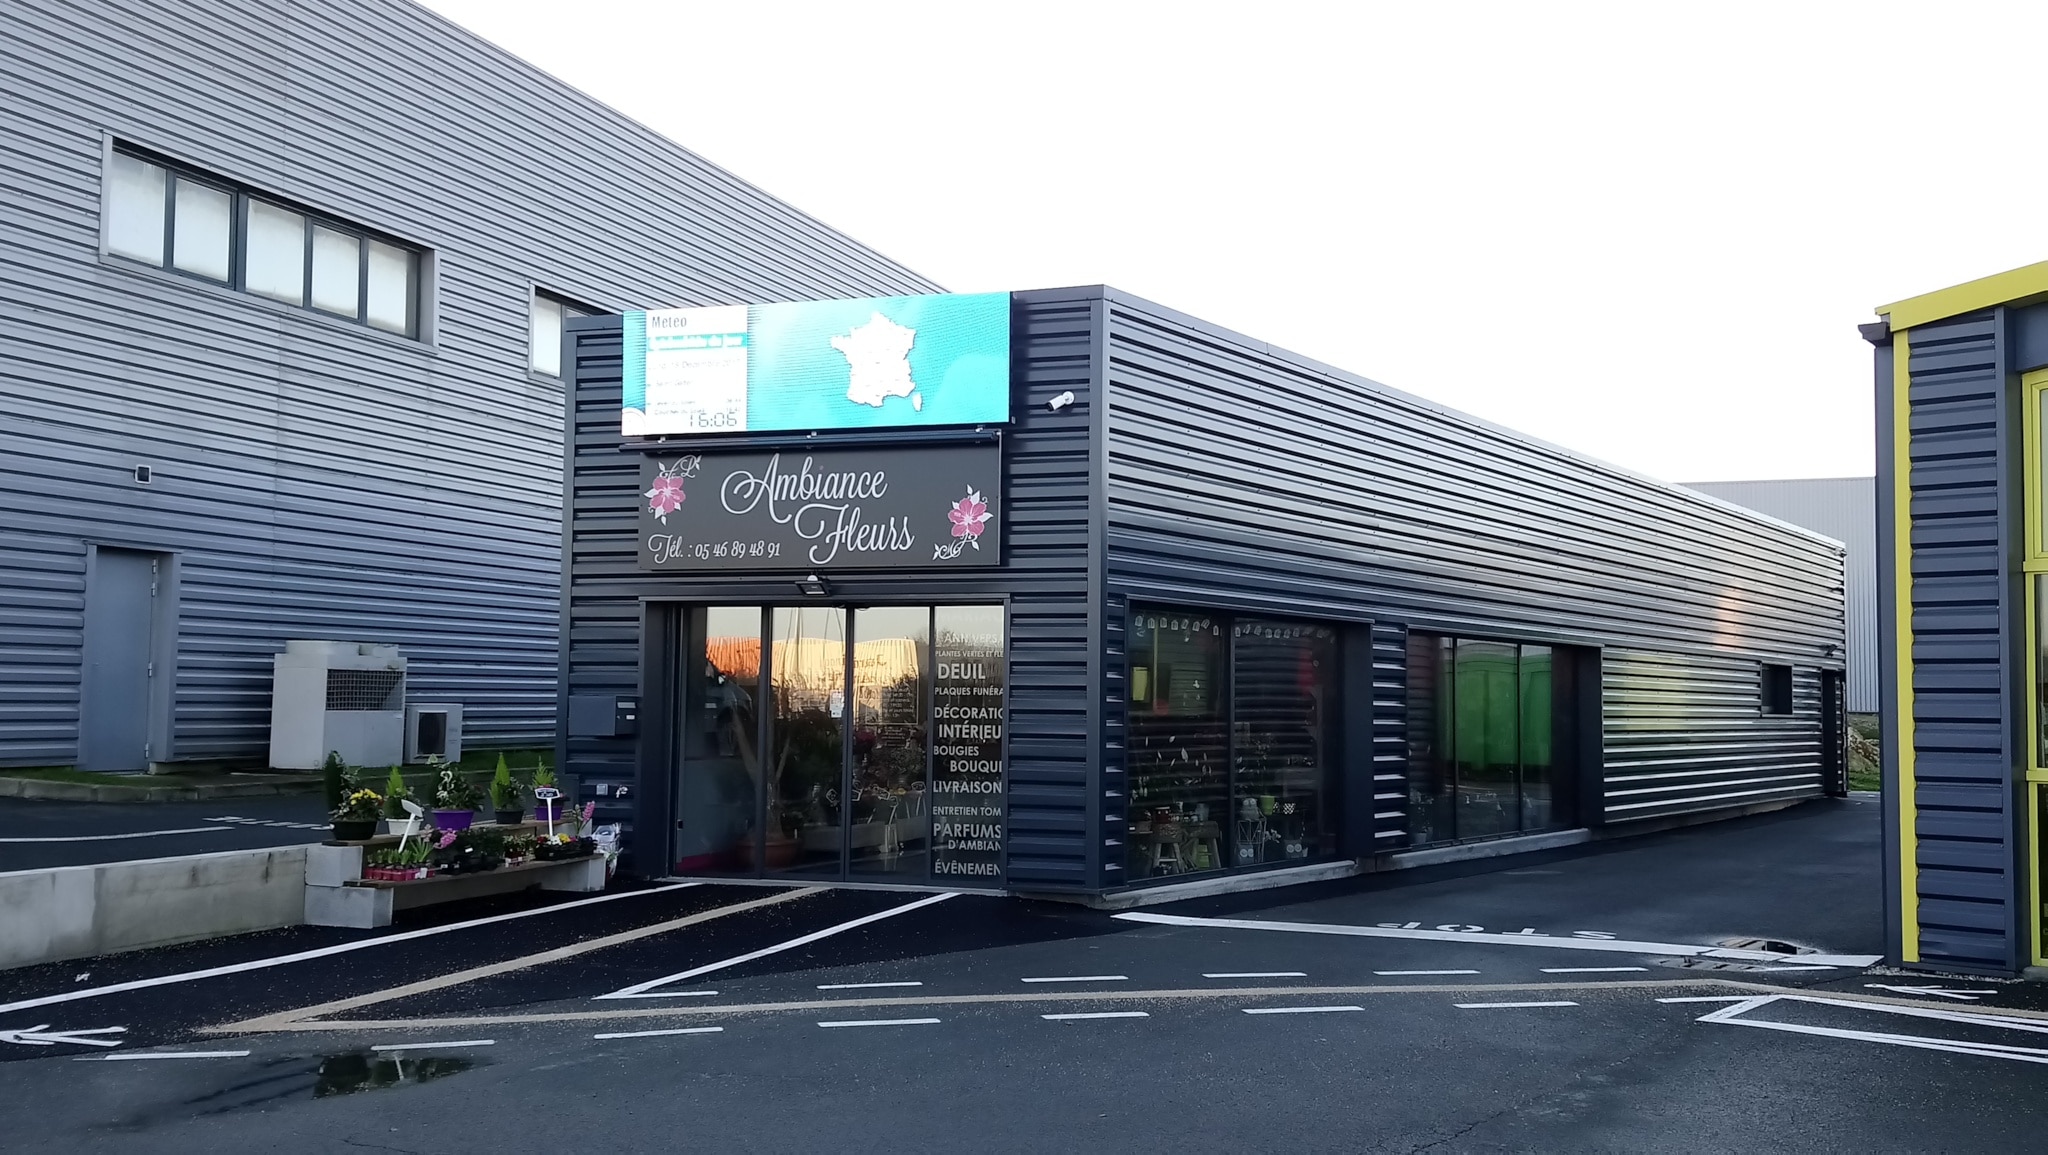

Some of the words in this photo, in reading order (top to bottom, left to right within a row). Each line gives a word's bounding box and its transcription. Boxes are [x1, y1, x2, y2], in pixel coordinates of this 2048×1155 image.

[690, 412, 738, 428] 16:06
[720, 453, 888, 524] Ambiance
[794, 503, 915, 564] Fleurs
[648, 533, 683, 564] Tél.
[695, 543, 710, 560] 05
[713, 541, 729, 557] 46
[731, 540, 746, 558] 89
[749, 540, 765, 557] 48
[768, 542, 781, 558] 91
[938, 663, 986, 680] DEUIL
[934, 686, 971, 696] PLAQUES
[933, 745, 979, 756] BOUGIES
[933, 780, 1002, 793] LIVRAISON
[932, 806, 978, 816] ENTRETIEN
[933, 823, 1002, 838] PARFUMS
